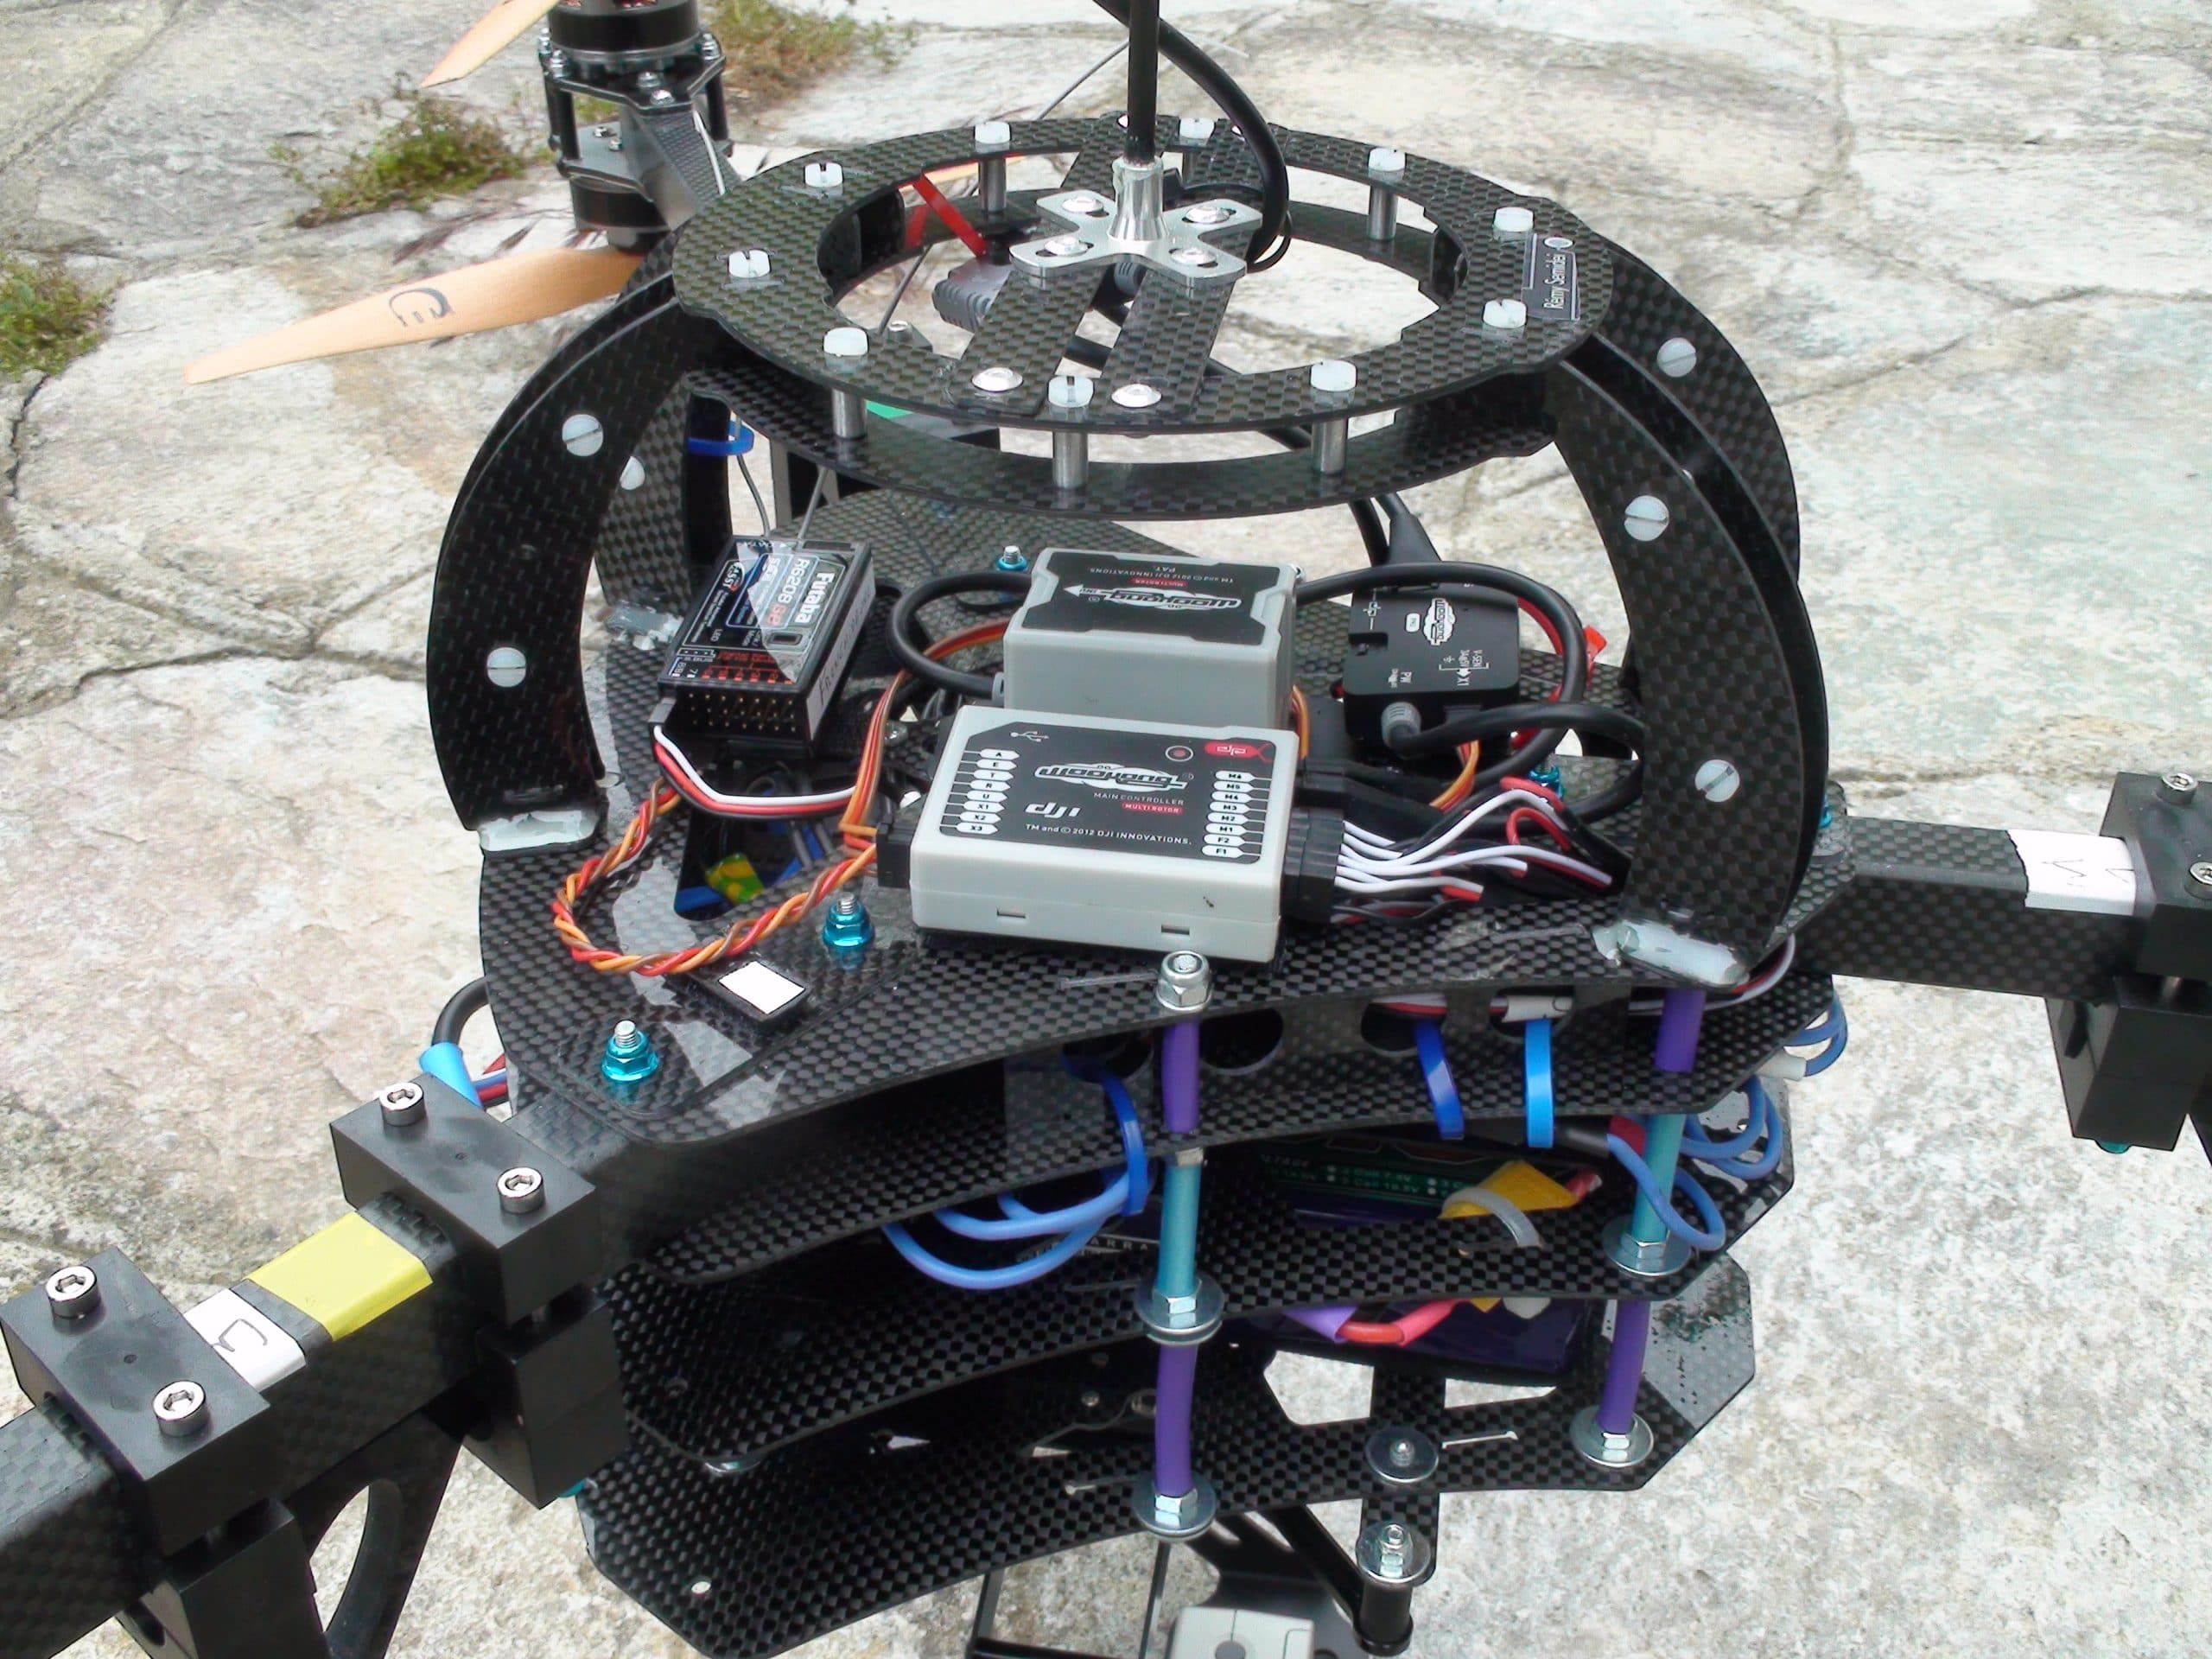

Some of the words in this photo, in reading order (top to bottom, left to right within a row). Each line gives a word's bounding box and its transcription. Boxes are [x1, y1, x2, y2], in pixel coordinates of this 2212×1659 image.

[795, 572, 836, 623] Futaba
[1093, 791, 1119, 800] MAIN
[1120, 794, 1185, 805] CONTROLLER
